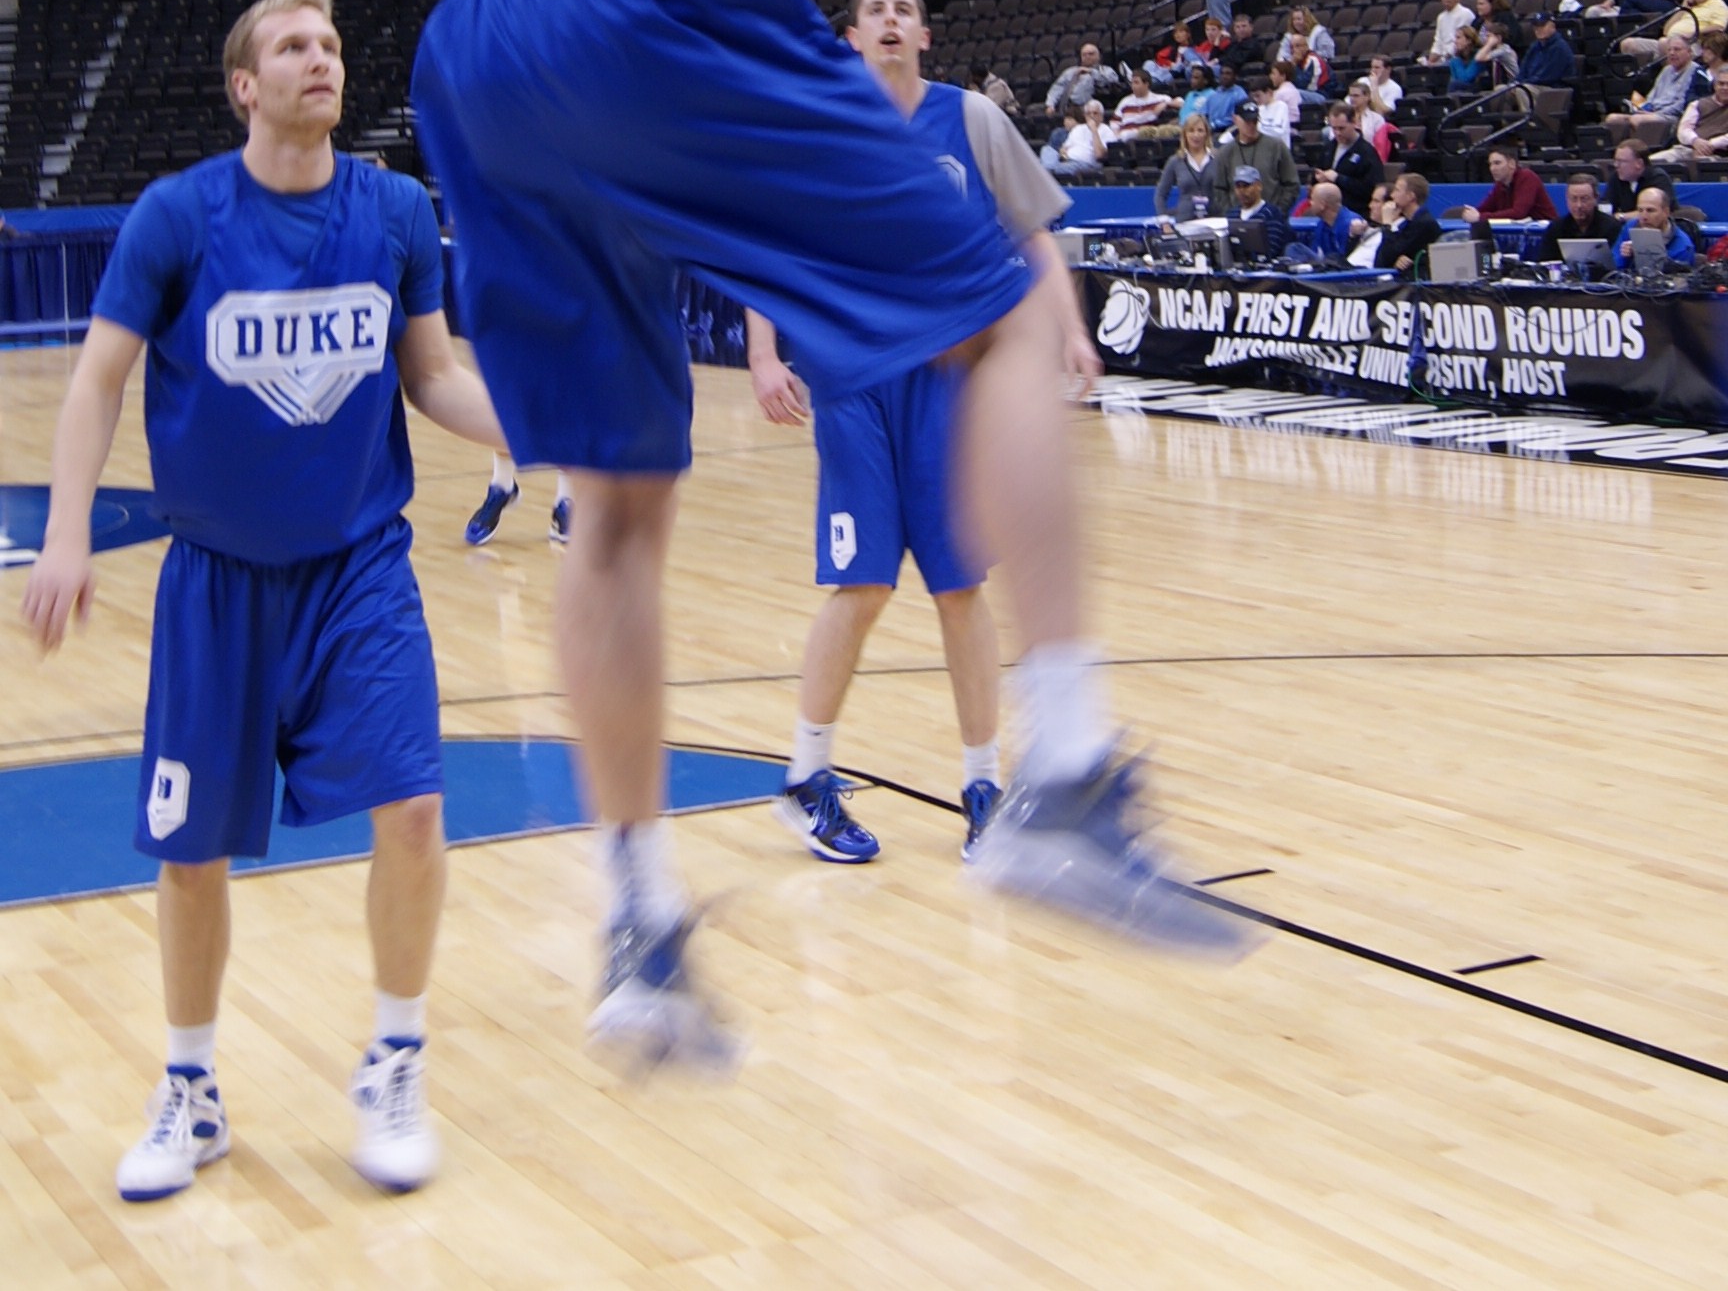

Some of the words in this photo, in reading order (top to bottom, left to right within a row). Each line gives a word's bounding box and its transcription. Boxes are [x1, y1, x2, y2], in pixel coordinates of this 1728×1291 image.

[234, 307, 375, 357] DUKE
[1233, 291, 1310, 338] FIRST
[1308, 296, 1372, 342] AND
[1375, 299, 1498, 352] SECOND
[1503, 305, 1645, 360] ROUNDS
[1501, 357, 1568, 397] HOST
